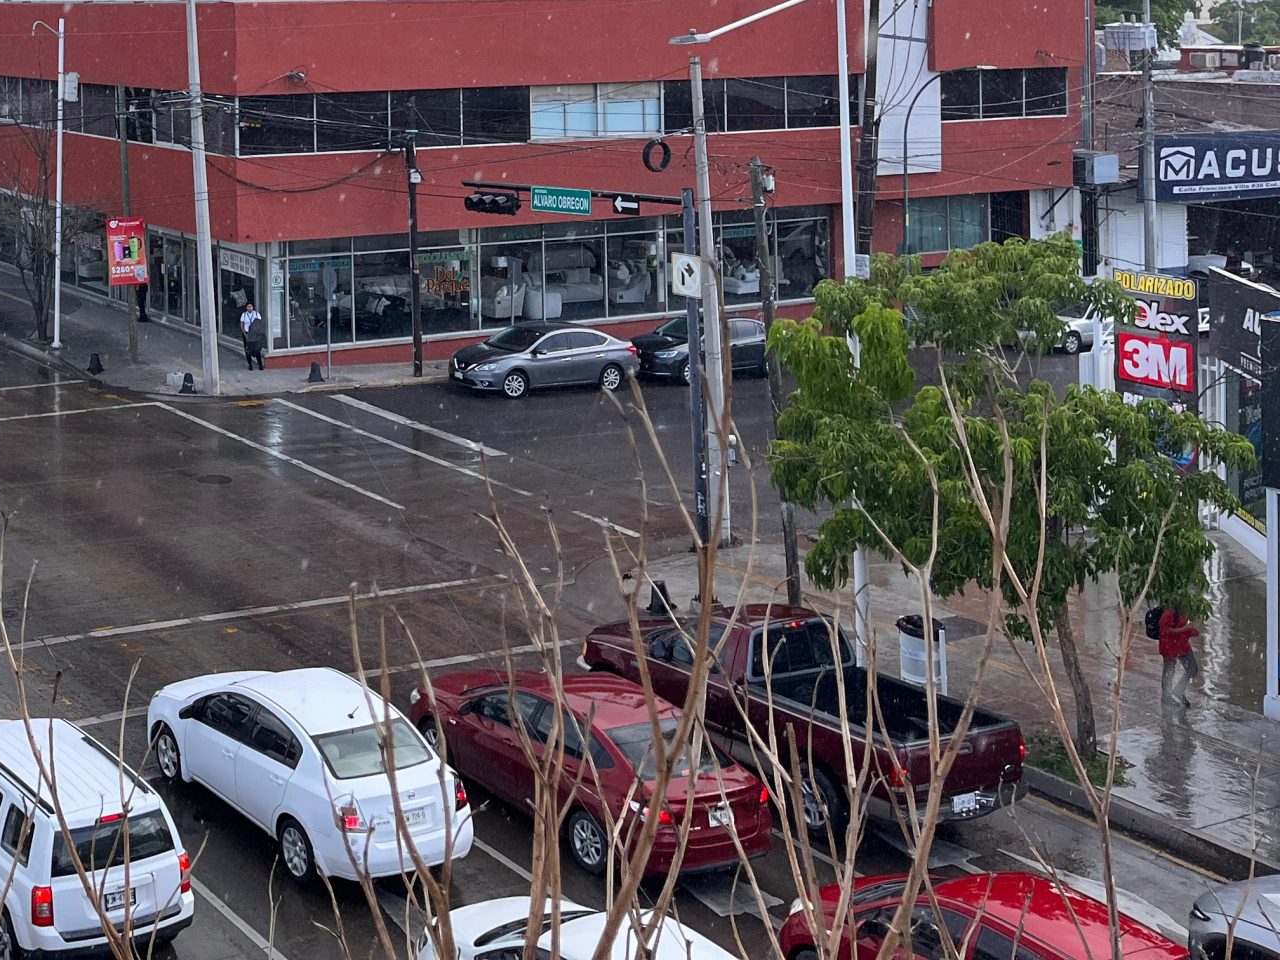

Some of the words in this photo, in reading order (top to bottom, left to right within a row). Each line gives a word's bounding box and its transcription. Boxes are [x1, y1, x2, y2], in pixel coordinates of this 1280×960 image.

[1160, 146, 1280, 181] MACU
[533, 194, 557, 208] ALVARO
[558, 195, 589, 210] OBREGON
[434, 266, 456, 281] Del
[426, 279, 469, 295] Parque
[1115, 271, 1195, 300] POLARIZADO
[1123, 339, 1188, 386] 3M
